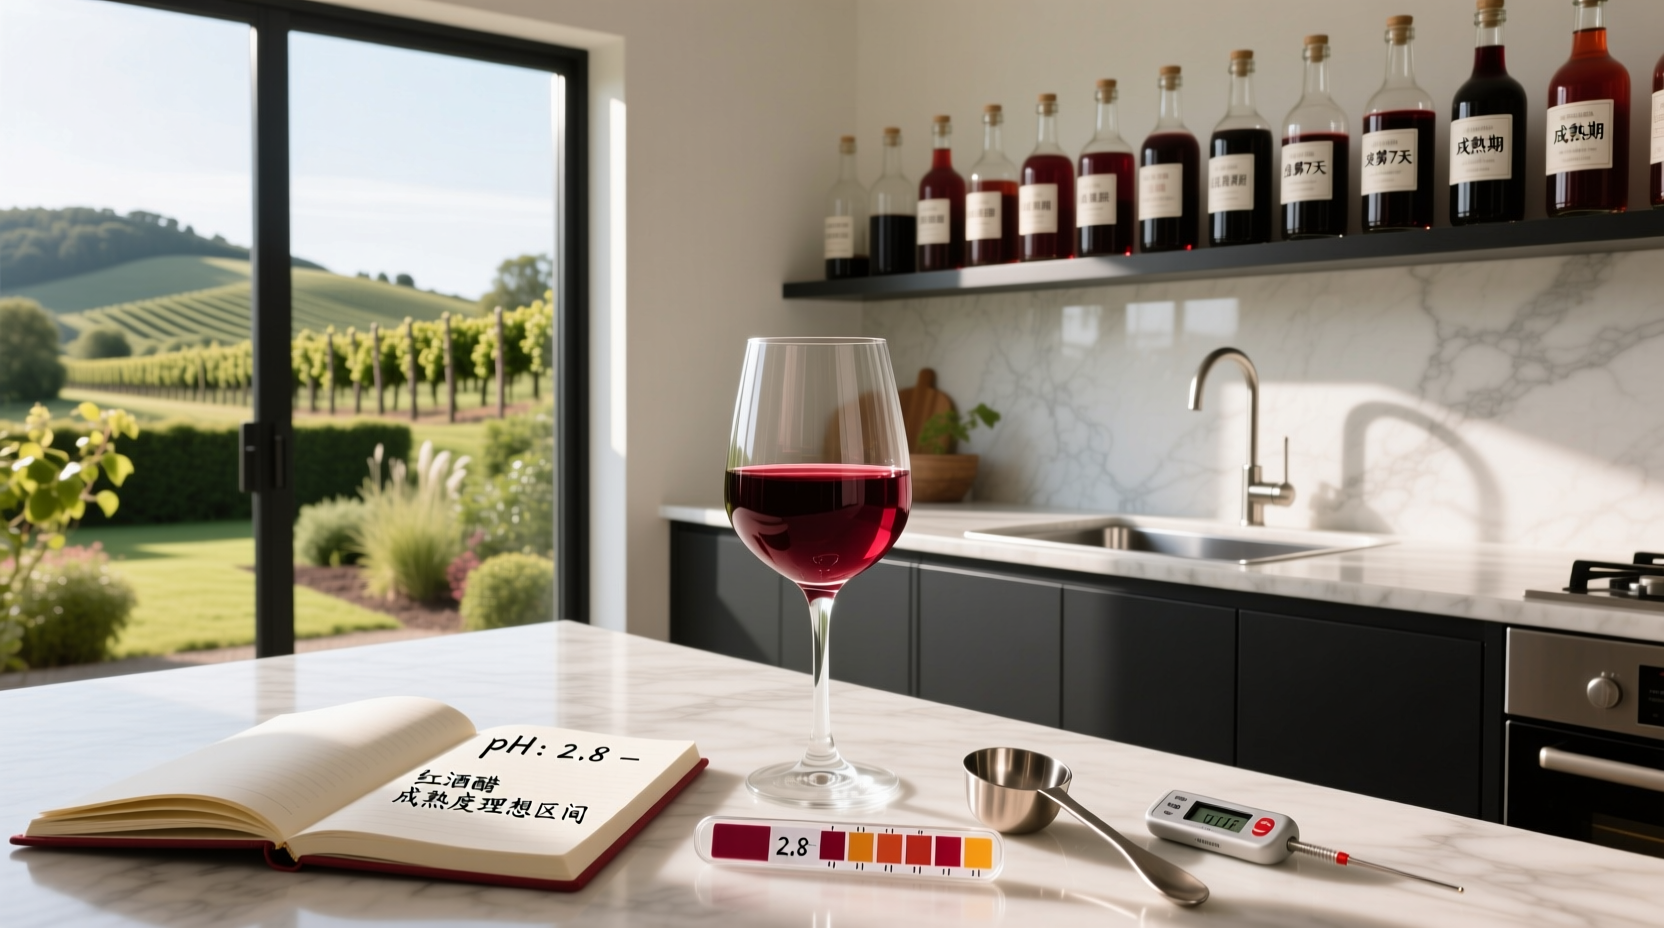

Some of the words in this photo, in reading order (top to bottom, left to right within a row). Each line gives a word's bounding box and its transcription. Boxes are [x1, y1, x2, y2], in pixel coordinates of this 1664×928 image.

[479, 734, 548, 759] pH:
[557, 743, 611, 763] 2.8
[391, 786, 589, 825] 成熟度理想区间
